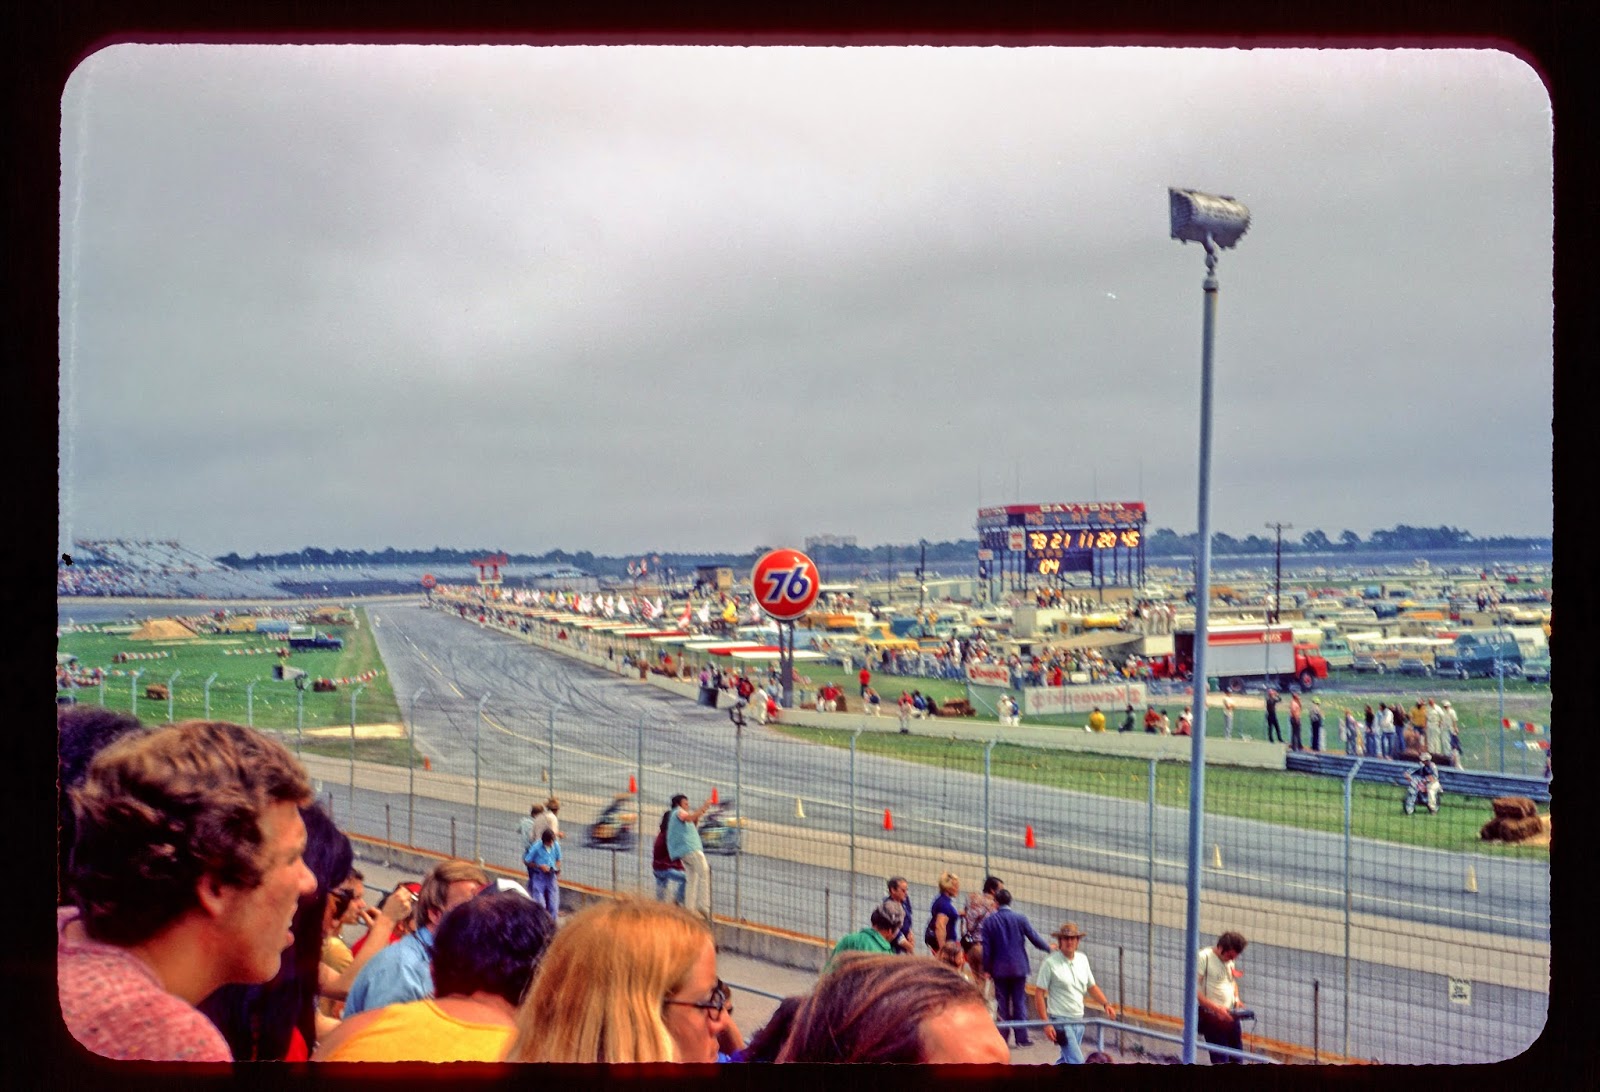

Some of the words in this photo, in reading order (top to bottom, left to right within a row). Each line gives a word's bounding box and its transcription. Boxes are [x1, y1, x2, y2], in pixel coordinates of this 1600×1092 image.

[1040, 503, 1125, 513] DAYTONA
[1050, 532, 1071, 549] 21
[1039, 558, 1060, 575] 04
[762, 563, 811, 603] 76
